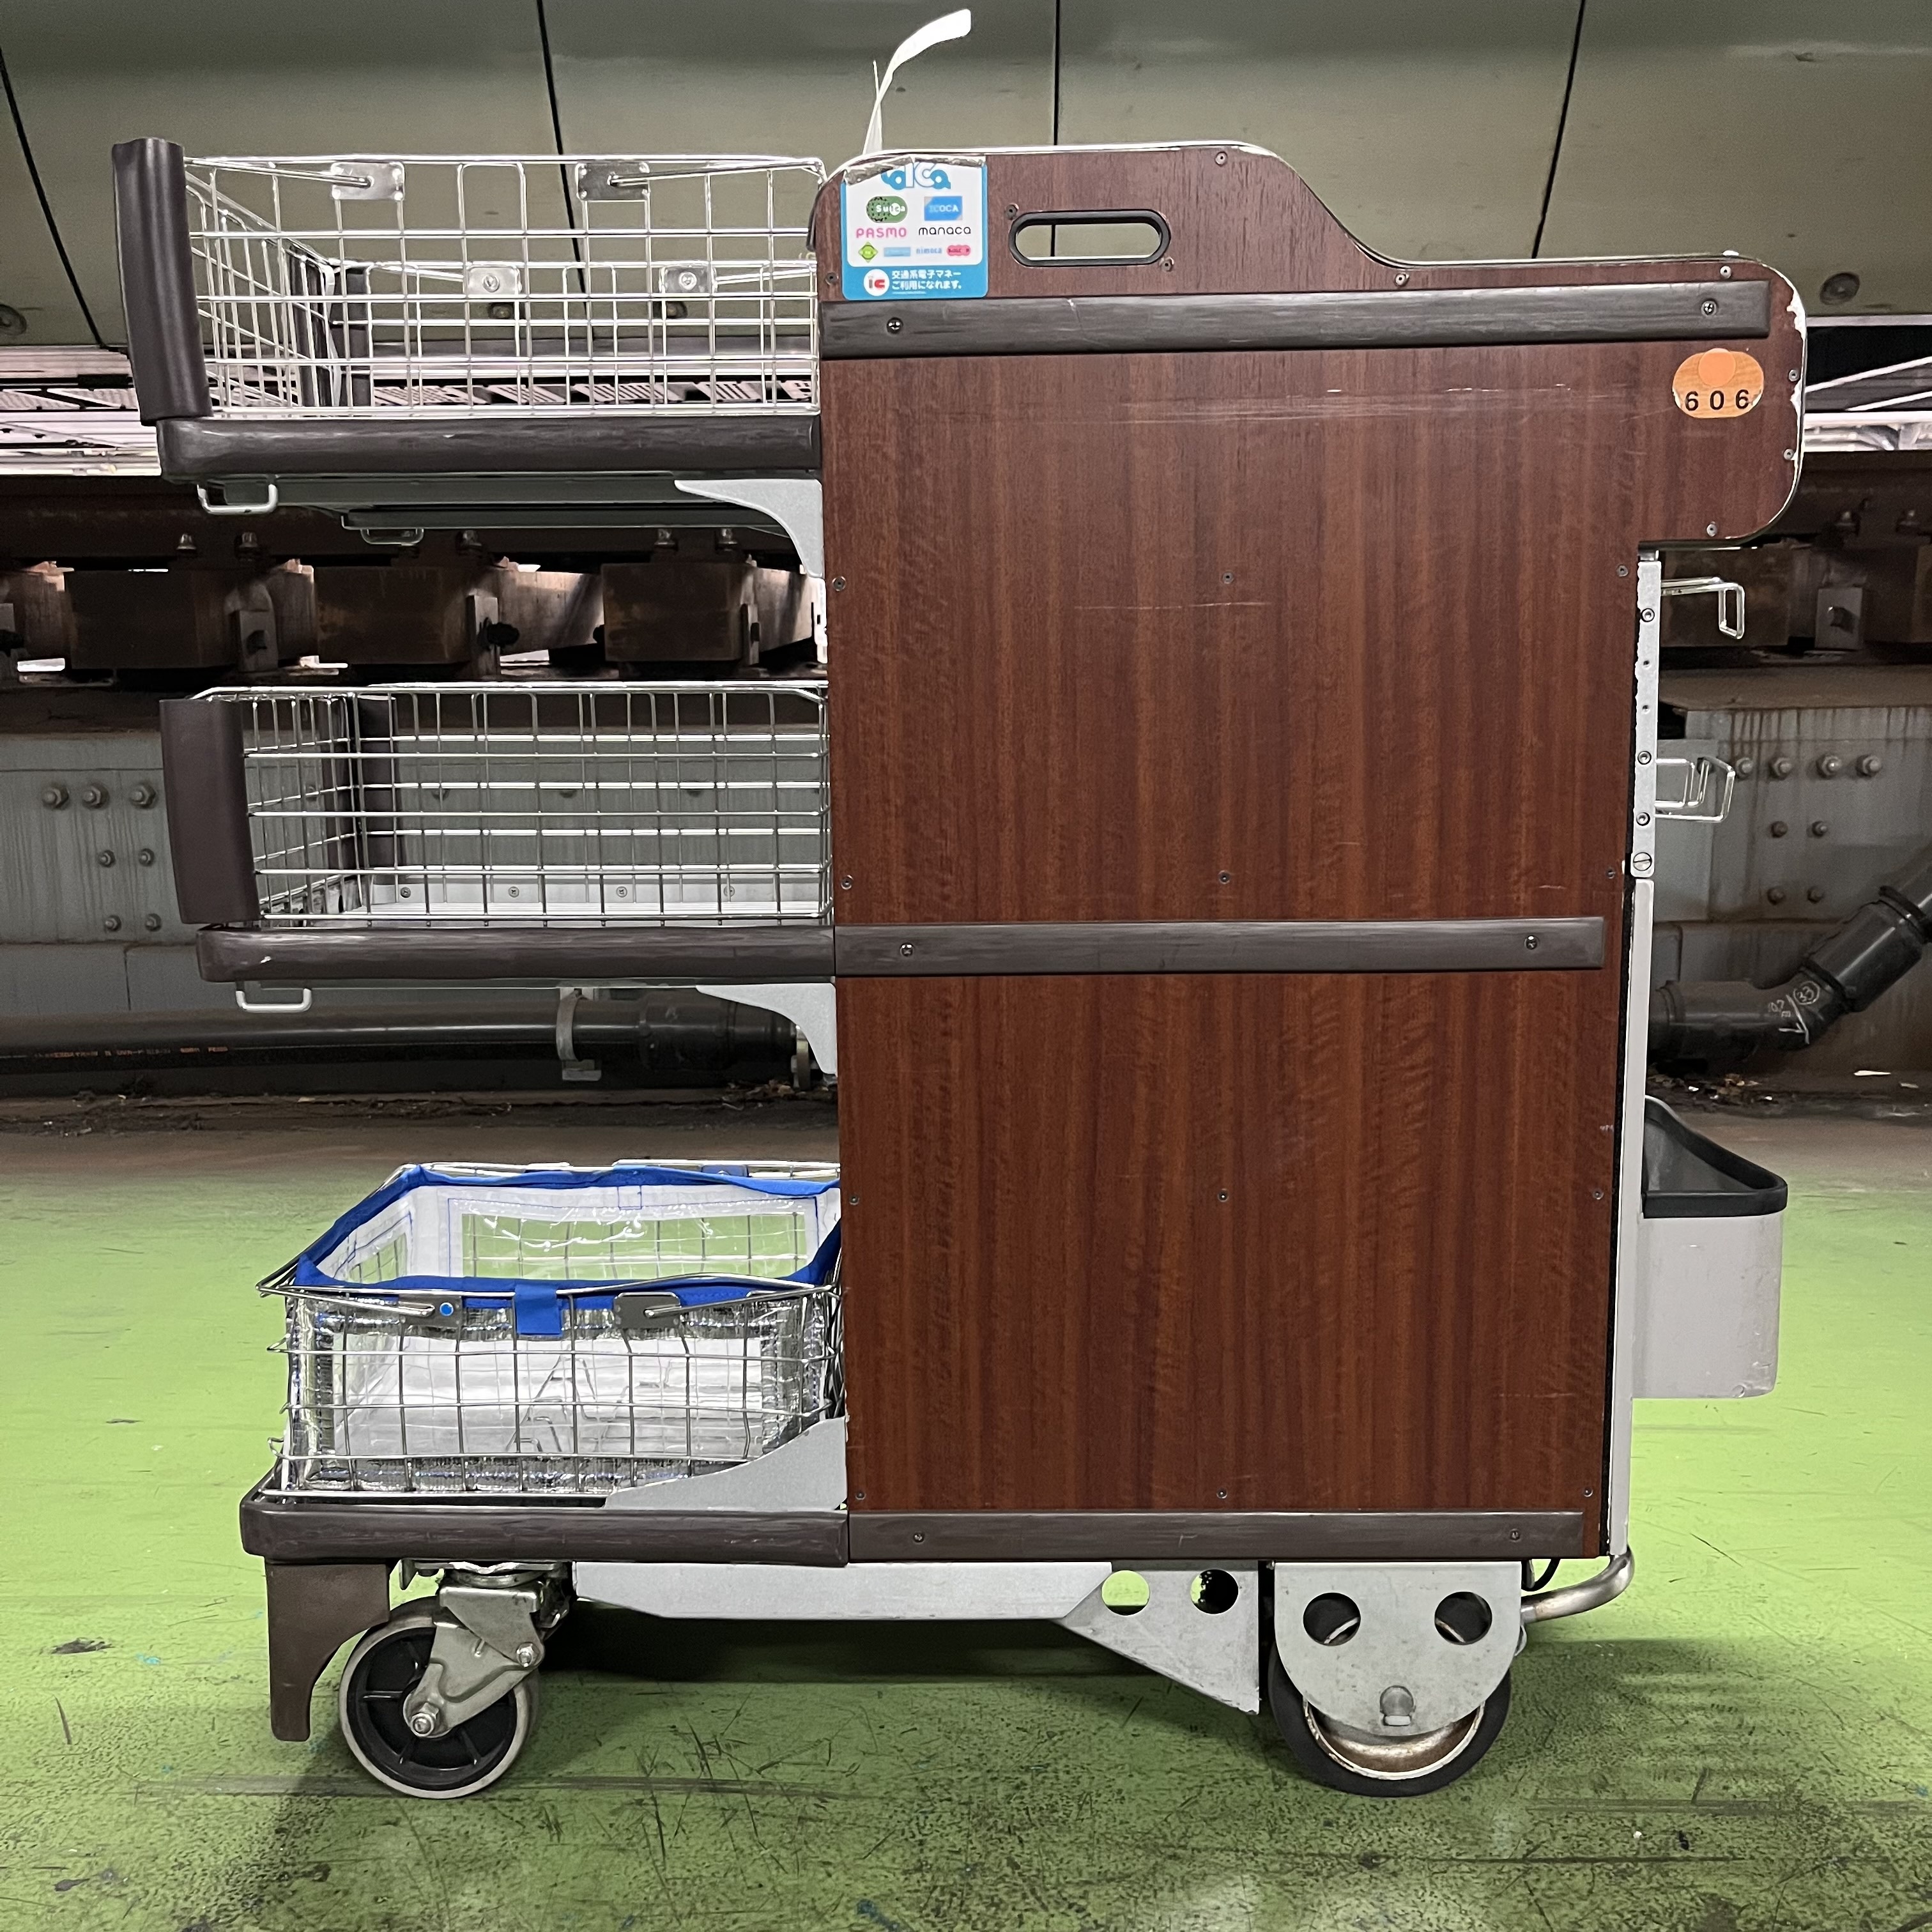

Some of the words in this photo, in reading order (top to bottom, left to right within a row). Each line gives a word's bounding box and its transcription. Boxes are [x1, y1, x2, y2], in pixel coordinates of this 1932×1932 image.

[929, 204, 960, 213] ICOCA
[855, 227, 907, 239] PASMO
[918, 226, 972, 236] manaca
[1685, 389, 1749, 411] 606
